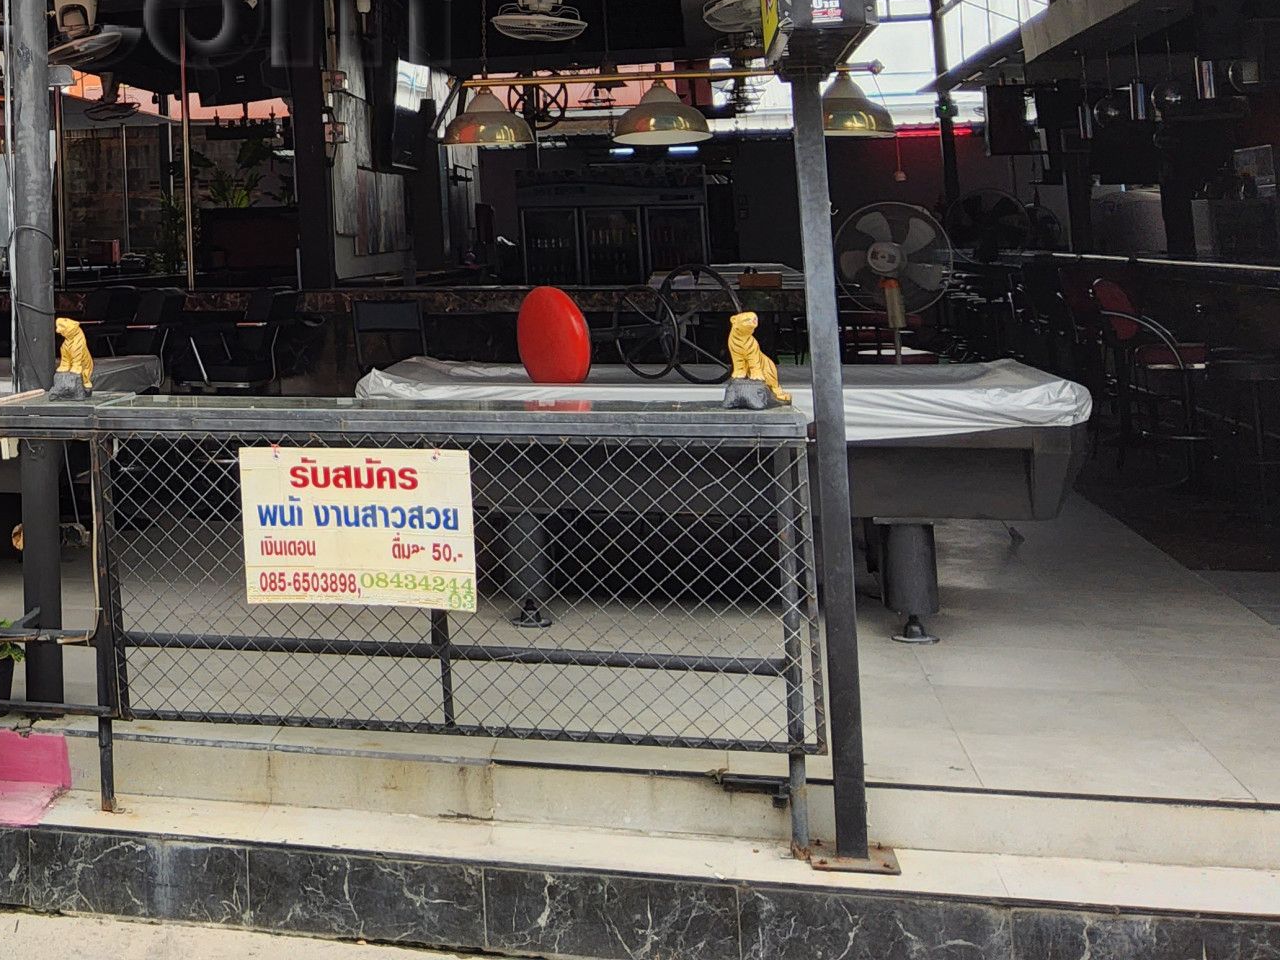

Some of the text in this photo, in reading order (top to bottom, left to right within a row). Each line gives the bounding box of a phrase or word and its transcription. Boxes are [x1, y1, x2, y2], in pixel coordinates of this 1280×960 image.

[289, 457, 419, 490] รับสมัคร
[313, 503, 459, 531] งานสาวสวย
